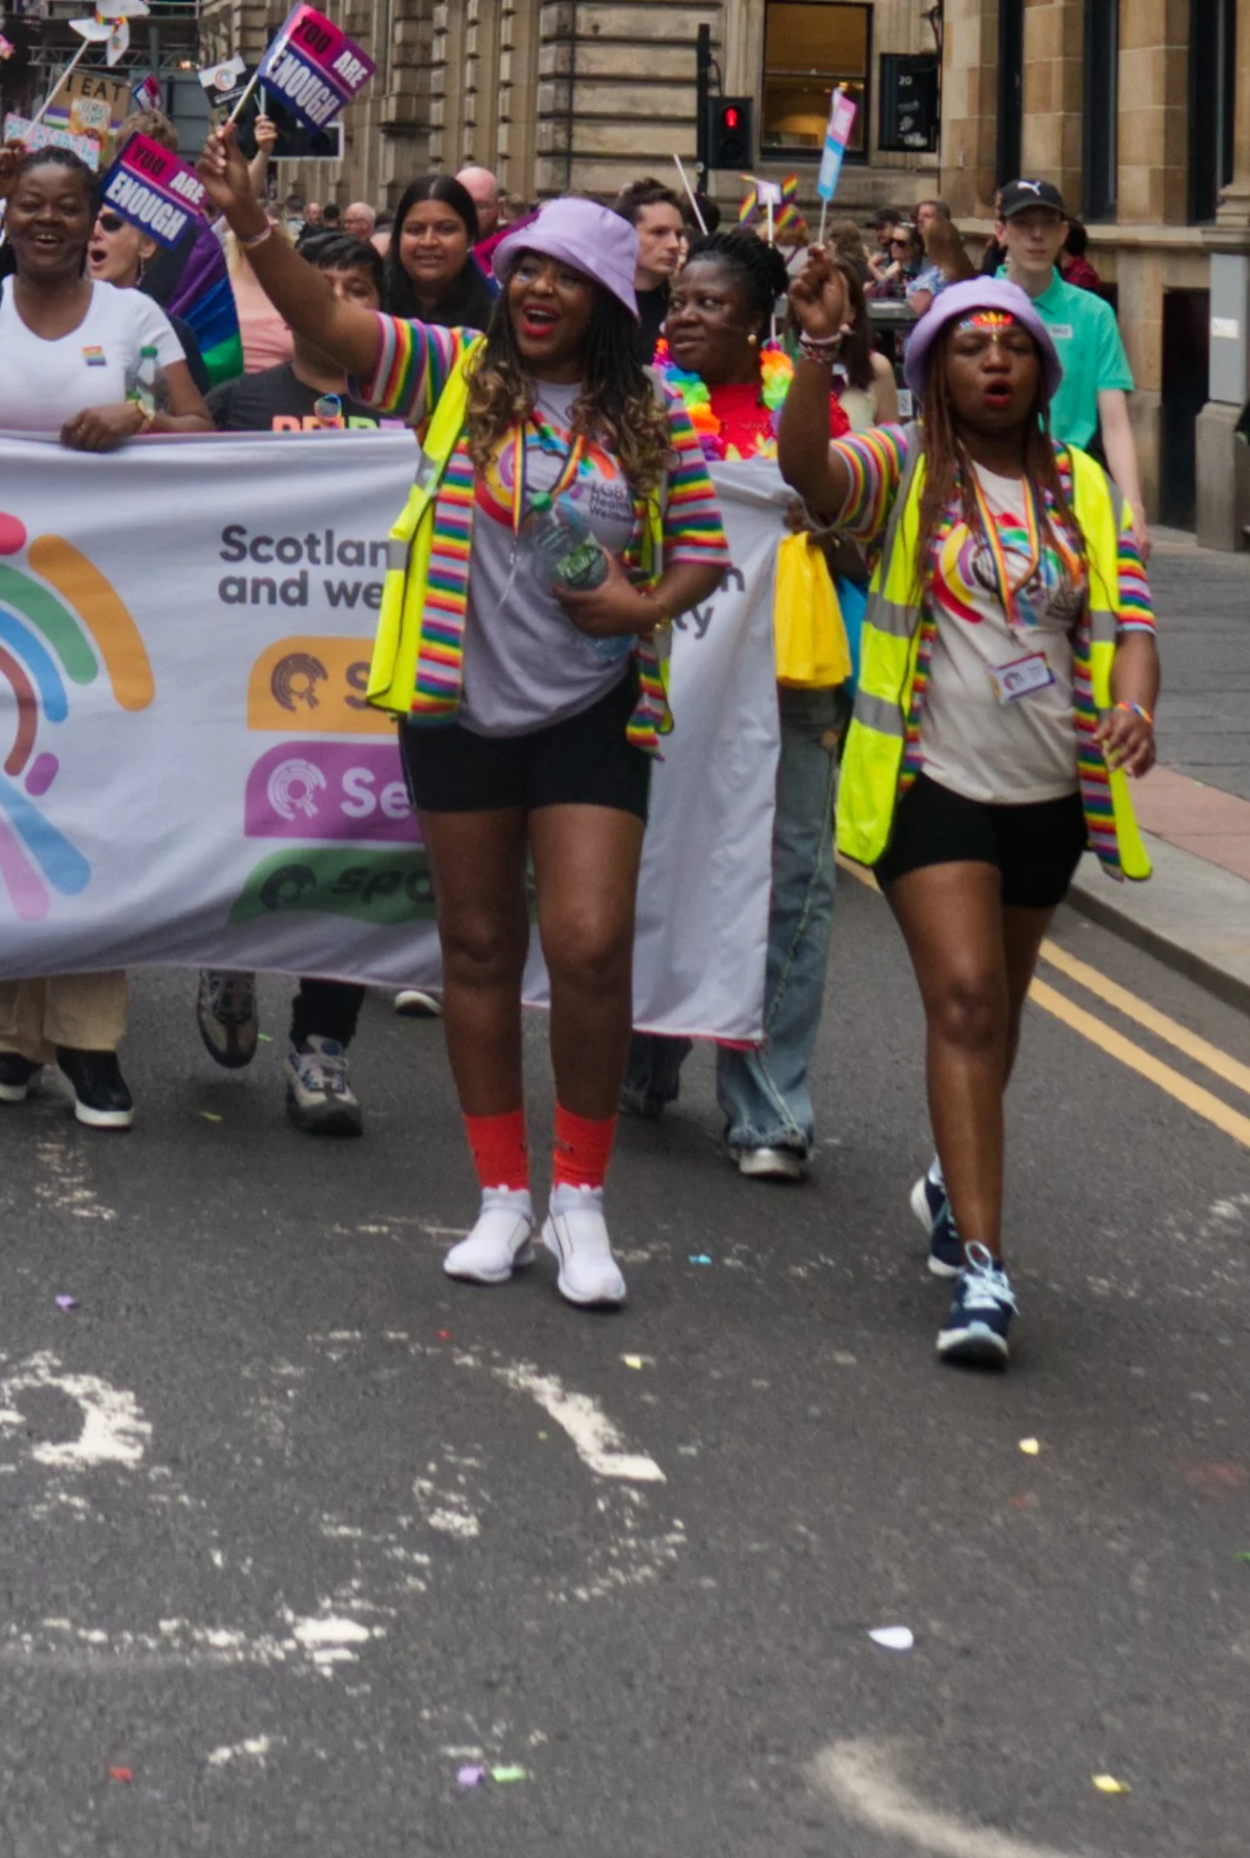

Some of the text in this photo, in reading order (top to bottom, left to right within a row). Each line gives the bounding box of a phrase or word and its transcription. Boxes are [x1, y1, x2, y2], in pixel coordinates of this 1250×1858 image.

[296, 15, 369, 88] YOU ARE
[66, 74, 124, 102] I EAT
[265, 48, 341, 126] ENOUGH
[105, 170, 188, 241] ENOUGH
[132, 144, 206, 204] YOU ARE
[218, 569, 308, 606] and
